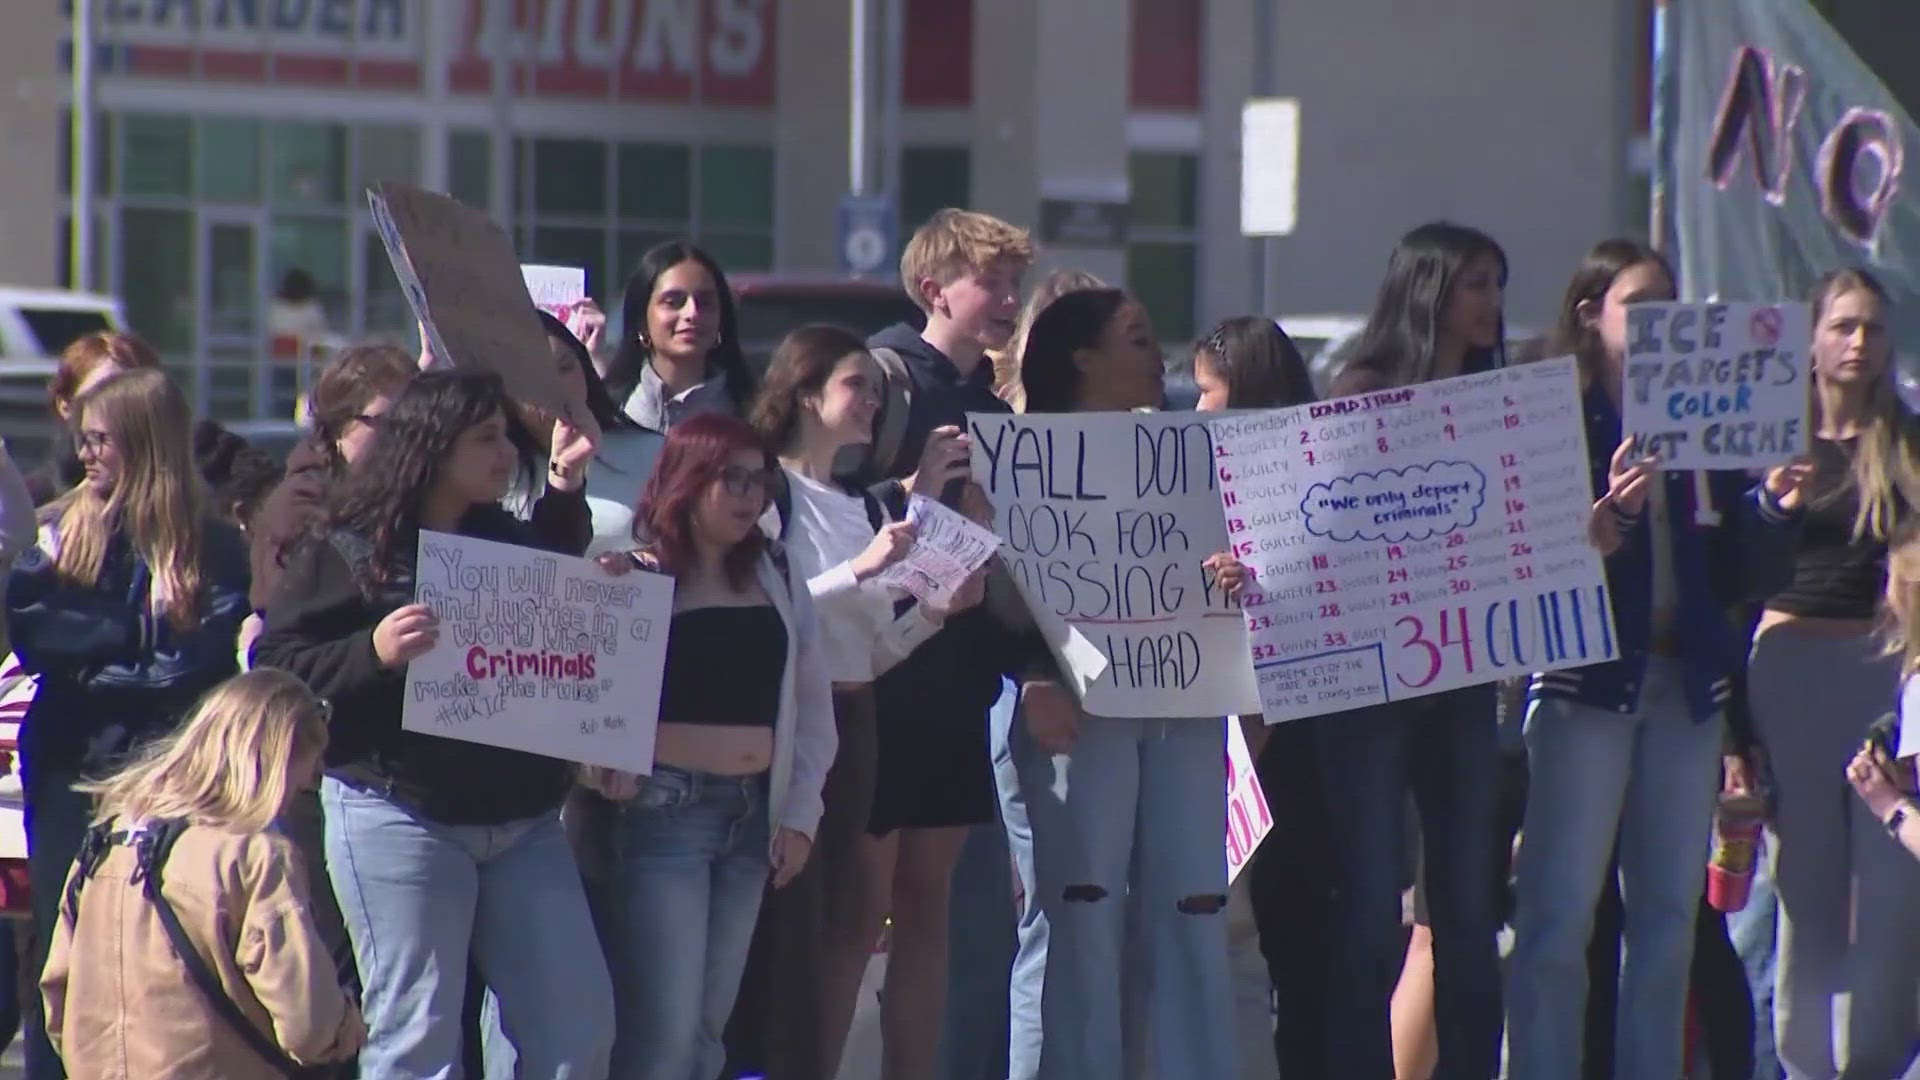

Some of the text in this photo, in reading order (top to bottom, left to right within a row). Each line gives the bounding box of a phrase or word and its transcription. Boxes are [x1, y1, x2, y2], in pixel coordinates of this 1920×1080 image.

[1703, 45, 1904, 250] NO
[1627, 305, 1729, 355] ICE
[1628, 348, 1797, 404] TARGETS
[1214, 410, 1300, 442] Defendant
[1309, 400, 1360, 419] DONALD
[1319, 421, 1366, 441] GUILTY
[1628, 418, 1799, 461] NOT CRIME
[971, 420, 1107, 500] Y'ALL
[1251, 511, 1300, 528] GUILTY
[1366, 491, 1406, 508] only
[1412, 481, 1471, 500] deport
[998, 503, 1096, 557] OOK
[1116, 510, 1189, 558] FOR
[1260, 535, 1306, 552] GUILTY
[424, 545, 642, 609] "You will never
[416, 583, 653, 642] find justice in a
[466, 646, 597, 681] Criminals
[1107, 631, 1200, 690] HARD
[1394, 607, 1473, 688] 34
[414, 672, 479, 702] make
[497, 674, 536, 699] the
